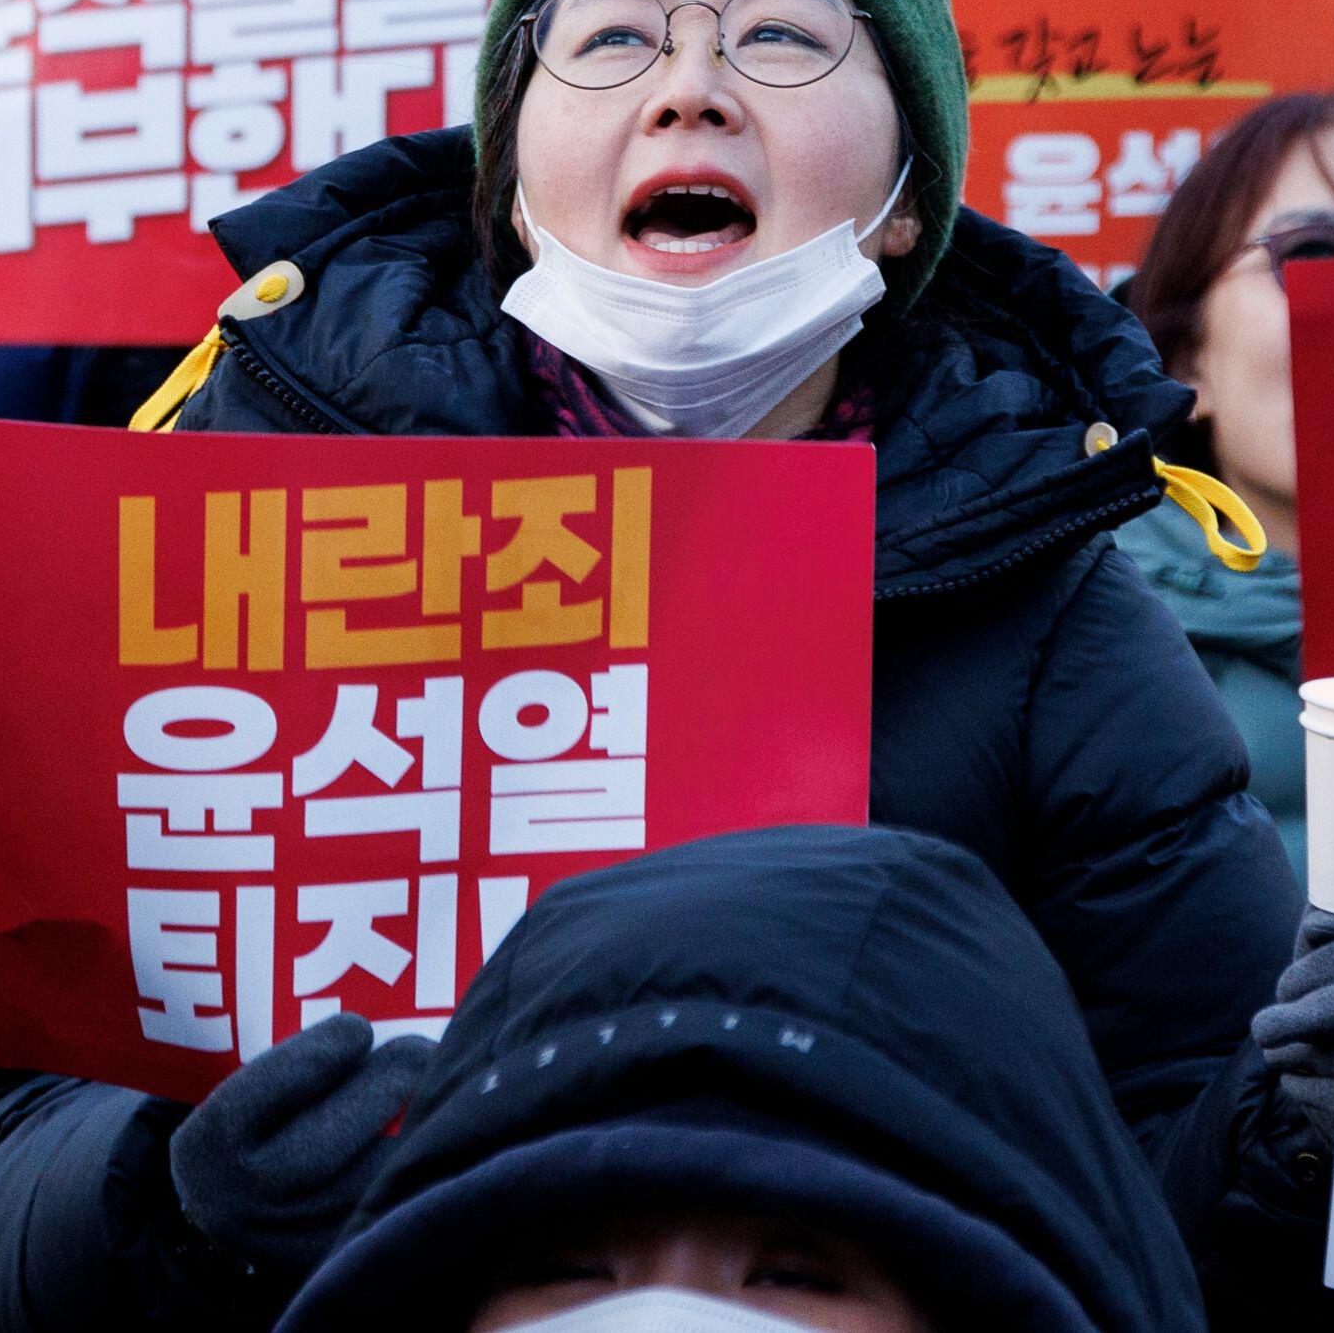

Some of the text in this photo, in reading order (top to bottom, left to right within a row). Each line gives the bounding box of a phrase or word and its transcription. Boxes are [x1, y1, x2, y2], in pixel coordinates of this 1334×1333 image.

[1003, 129, 1215, 236] 윤석
[116, 465, 653, 672] 내란죄
[115, 663, 650, 873] 윤석열
